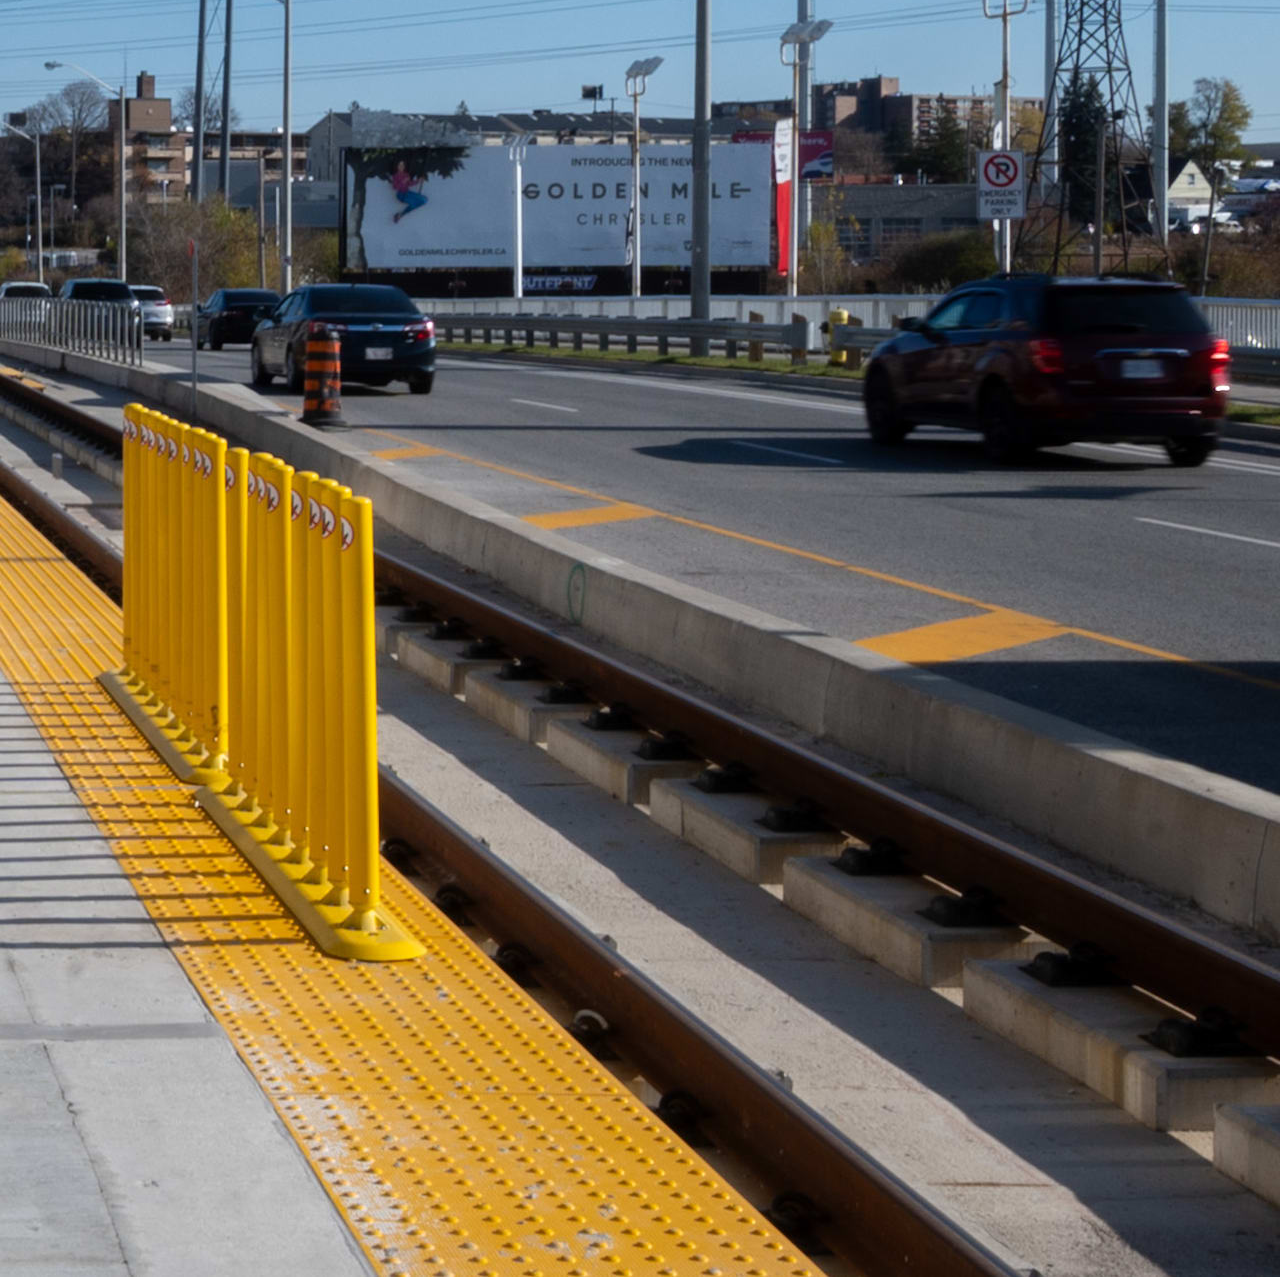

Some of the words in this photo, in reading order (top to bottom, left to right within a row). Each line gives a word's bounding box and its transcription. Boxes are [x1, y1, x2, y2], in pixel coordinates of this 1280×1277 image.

[571, 157, 645, 167] INTRODUCIG
[647, 157, 669, 167] THE
[671, 182, 751, 200] MLE
[984, 198, 1018, 206] PARKING
[991, 207, 1011, 216] ONLY
